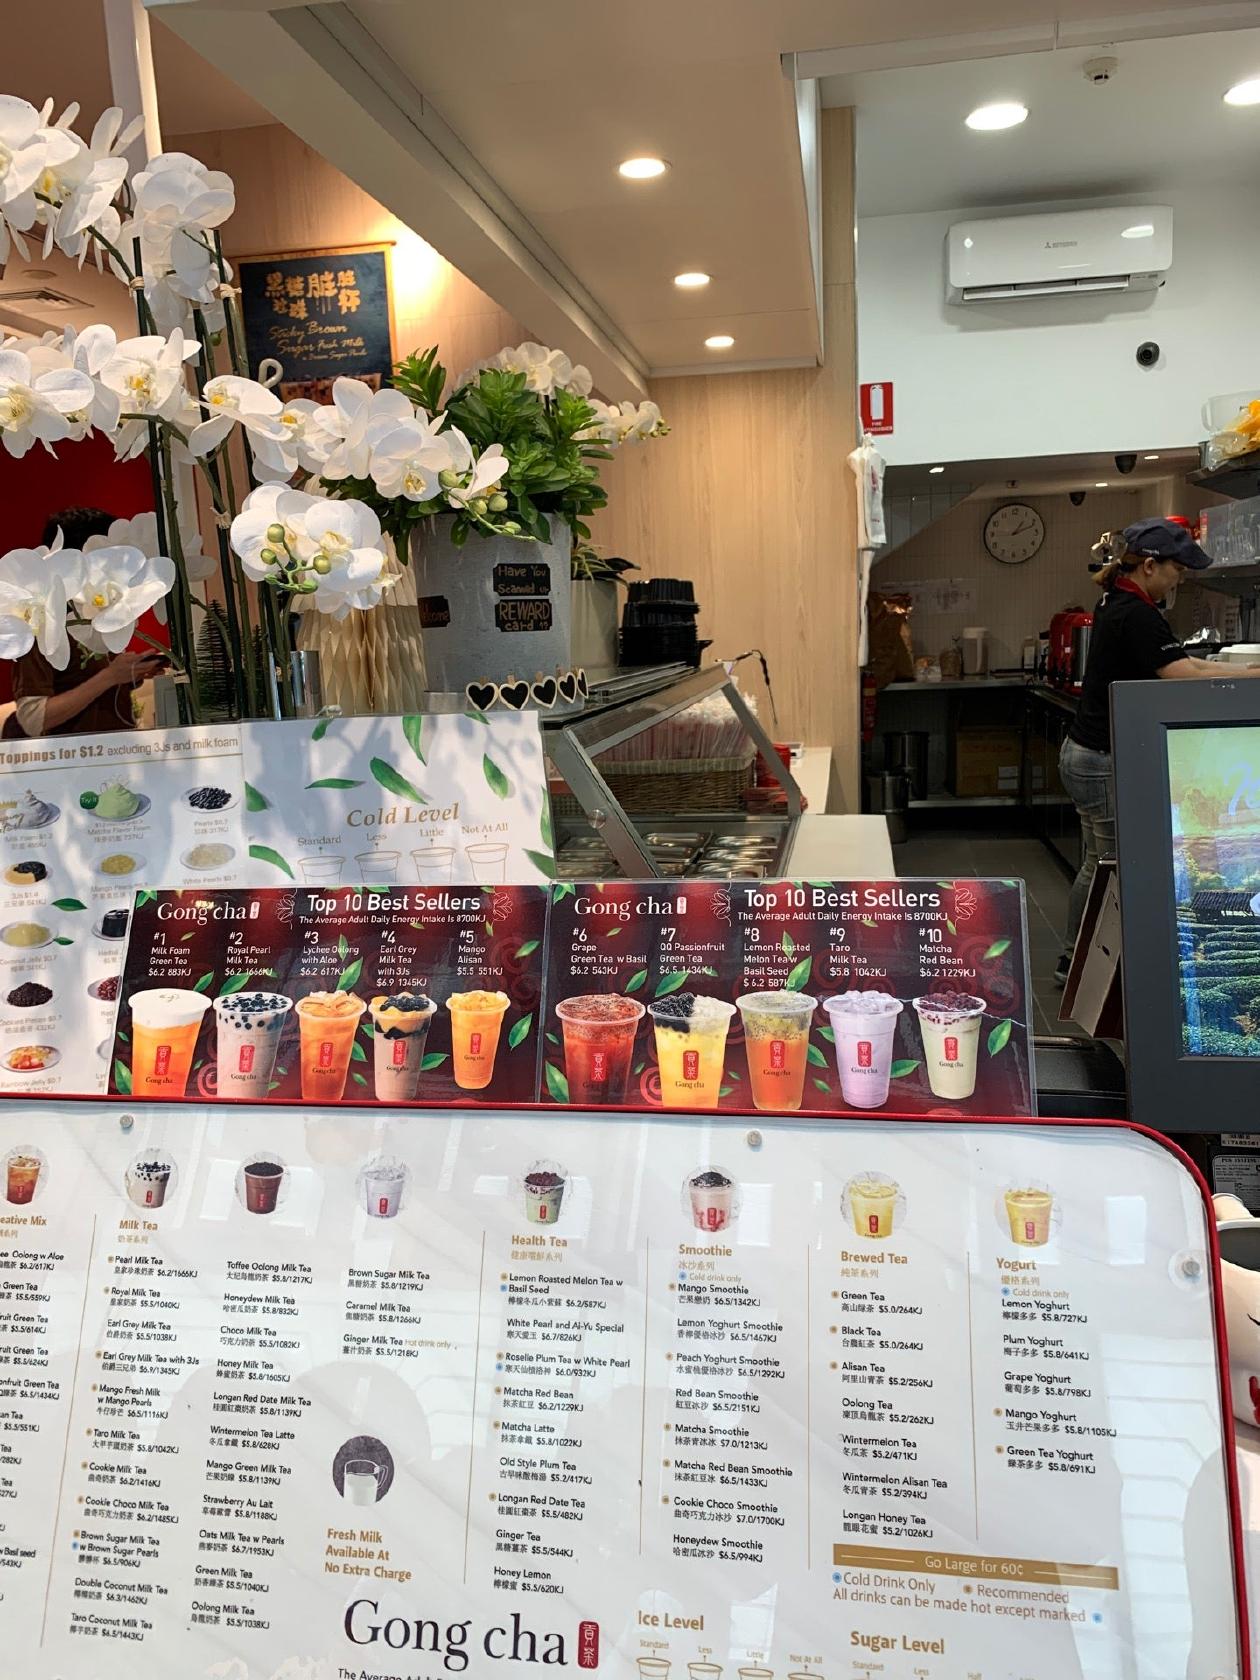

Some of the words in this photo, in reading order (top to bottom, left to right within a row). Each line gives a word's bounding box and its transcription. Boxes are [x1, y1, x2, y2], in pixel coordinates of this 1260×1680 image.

[306, 321, 347, 334] Brown
[498, 566, 527, 577] Have
[532, 565, 547, 576] You
[500, 601, 549, 620] REWARD
[505, 621, 534, 631] card
[0, 751, 55, 765] Toppings
[59, 748, 76, 759] for
[80, 745, 104, 758] $1.2
[107, 743, 152, 757] excluding
[173, 740, 191, 751] and
[193, 738, 212, 750] milk
[214, 737, 238, 747] foam
[346, 807, 398, 827] Cold
[403, 802, 460, 823] Level
[419, 827, 444, 837] Little
[462, 825, 480, 834] Not
[483, 824, 493, 833] At
[495, 823, 509, 832] All
[298, 835, 342, 847] Standard
[366, 832, 387, 842] Less
[308, 895, 337, 915] Top
[344, 895, 362, 911] 10
[367, 894, 409, 911] Best
[414, 893, 480, 911] Sellers
[744, 889, 777, 911] Top
[784, 889, 806, 907] 10
[812, 889, 858, 907] Best
[864, 889, 940, 907] Sellers
[157, 902, 208, 925] Gong
[213, 902, 246, 920] cha
[574, 898, 631, 921] Gong
[636, 896, 673, 915] cha
[738, 912, 754, 921] The
[755, 912, 791, 922] Average
[793, 912, 815, 921] Adult
[818, 912, 838, 921] Daily
[842, 912, 872, 922] Energy
[875, 912, 902, 921] Intake
[905, 912, 912, 921] Is
[914, 912, 948, 921] 8700KJ
[154, 932, 166, 945] #1
[229, 932, 243, 945] #2
[304, 931, 319, 944] #3
[381, 931, 396, 944] #4
[460, 930, 474, 943] #5
[572, 928, 588, 942] #6
[660, 928, 676, 942] #7
[744, 928, 760, 942] #8
[830, 928, 846, 942] #9
[919, 928, 942, 943] #10
[227, 946, 249, 956] Royal
[250, 946, 271, 954] Pearl
[303, 945, 331, 955] Lychee
[380, 945, 397, 953] Earl
[398, 945, 417, 955] Grey
[458, 945, 486, 954] Mango
[572, 943, 597, 953] Grape
[660, 943, 672, 951] QQ
[675, 943, 725, 951] Passionfruit
[830, 944, 850, 952] Taro
[919, 944, 952, 953] Matcha
[150, 957, 172, 965] Green
[174, 957, 187, 965] Tea
[226, 956, 244, 964] Milk
[245, 956, 258, 964] Tea
[399, 956, 412, 964] Tea
[457, 956, 483, 964] Alisan
[571, 955, 596, 963] Green
[598, 955, 613, 963] Tea
[626, 954, 647, 963] Basil
[744, 956, 769, 964] Melon
[771, 956, 788, 964] Tea
[830, 956, 849, 964] Milk
[851, 956, 867, 964] Tea
[919, 956, 937, 964] Red
[940, 956, 963, 965] Bean
[149, 968, 165, 976] $6.2
[167, 968, 191, 976] 883KJ
[378, 968, 395, 976] with
[396, 968, 410, 976] 3Js
[457, 967, 474, 976] $5.5
[478, 967, 503, 976] 551KJ
[744, 967, 765, 976] Basil
[767, 967, 789, 976] Seed
[830, 968, 849, 977] $5.8
[854, 968, 886, 977] 1042KJ
[919, 968, 940, 977] $6.2
[942, 968, 976, 977] 1229KJ
[119, 1219, 141, 1230] Milk
[143, 1220, 158, 1231] Tea
[511, 1235, 546, 1247] Health
[549, 1236, 568, 1248] Tea
[679, 1244, 733, 1257] Smoothie
[841, 1251, 884, 1265] Brewed
[887, 1253, 908, 1265] Tea
[997, 1257, 1037, 1271] Yogurt
[678, 1283, 708, 1295] Mango
[709, 1283, 749, 1295] Smoothie
[841, 1290, 868, 1302] Green
[869, 1291, 885, 1302] Tea
[1004, 1371, 1033, 1385] Grape
[1034, 1373, 1072, 1386] Yoghurt
[203, 1494, 244, 1508] Strawberry
[246, 1498, 257, 1508] Au
[259, 1499, 273, 1509] Lait
[327, 1528, 357, 1541] Fresh
[359, 1531, 383, 1544] Milk
[326, 1544, 375, 1560] Available
[377, 1550, 390, 1561] At
[325, 1562, 340, 1574] No
[342, 1564, 371, 1577] Extra
[373, 1566, 412, 1582] Charge
[925, 1555, 942, 1568] Go
[945, 1558, 977, 1573] Large
[981, 1560, 998, 1572] for
[1000, 1562, 1024, 1576] 60¢
[494, 1566, 520, 1580] Honey
[522, 1568, 552, 1580] Lemon
[843, 1572, 873, 1586] Cold
[874, 1575, 905, 1589] Drink
[908, 1578, 935, 1594] Only
[976, 1585, 1070, 1603] Recommended
[833, 1588, 848, 1601] All
[850, 1589, 887, 1604] drinks
[890, 1594, 912, 1607] can
[914, 1594, 930, 1608] be
[933, 1597, 967, 1613] made
[971, 1601, 991, 1614] hot
[995, 1604, 1036, 1620] except
[1039, 1606, 1086, 1623] marked
[638, 1610, 659, 1627] Ice
[664, 1613, 705, 1631] Level
[344, 1599, 473, 1672] Gong
[483, 1613, 569, 1666] cha
[850, 1631, 897, 1652] Sugar
[902, 1635, 945, 1655] Level
